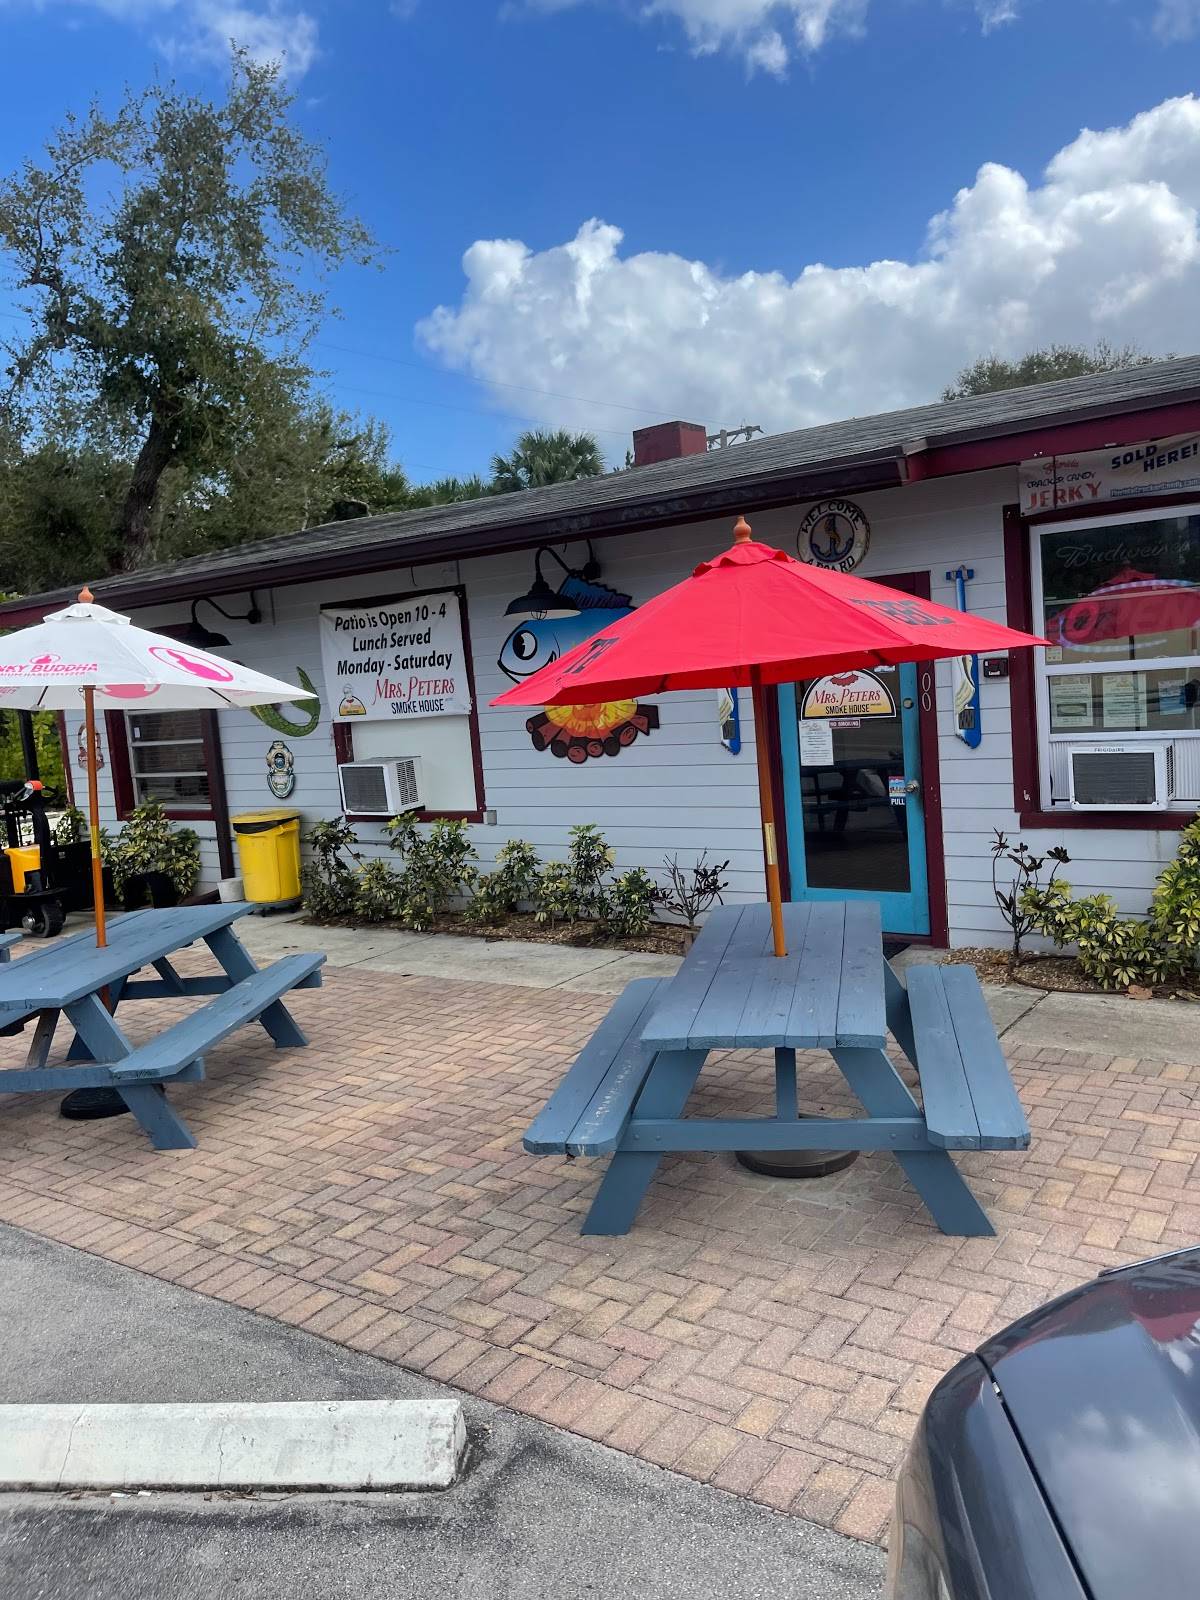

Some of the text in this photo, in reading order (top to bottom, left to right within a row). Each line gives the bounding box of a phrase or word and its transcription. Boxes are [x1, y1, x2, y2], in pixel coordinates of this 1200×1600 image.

[1111, 445, 1158, 470] SOLD
[1143, 443, 1198, 473] HERE!
[1026, 471, 1097, 489] CRACKR CANDY
[1025, 481, 1102, 510] JERKY
[801, 500, 860, 534] WELCOME
[335, 613, 366, 632] Patio
[366, 613, 378, 628] is
[379, 611, 411, 629] Open
[415, 605, 429, 622] 10
[439, 602, 447, 618] 4
[353, 626, 431, 652] Lunch Served
[30, 663, 98, 672] BUDDHA
[337, 657, 384, 676] Monday
[394, 650, 452, 670] Saturday
[404, 676, 456, 704] PETERS
[838, 688, 881, 706] PETERS
[391, 698, 445, 715] SMOKE HOUSE
[825, 703, 870, 715] SMOKE HOUSE
[890, 798, 906, 806] PULL
